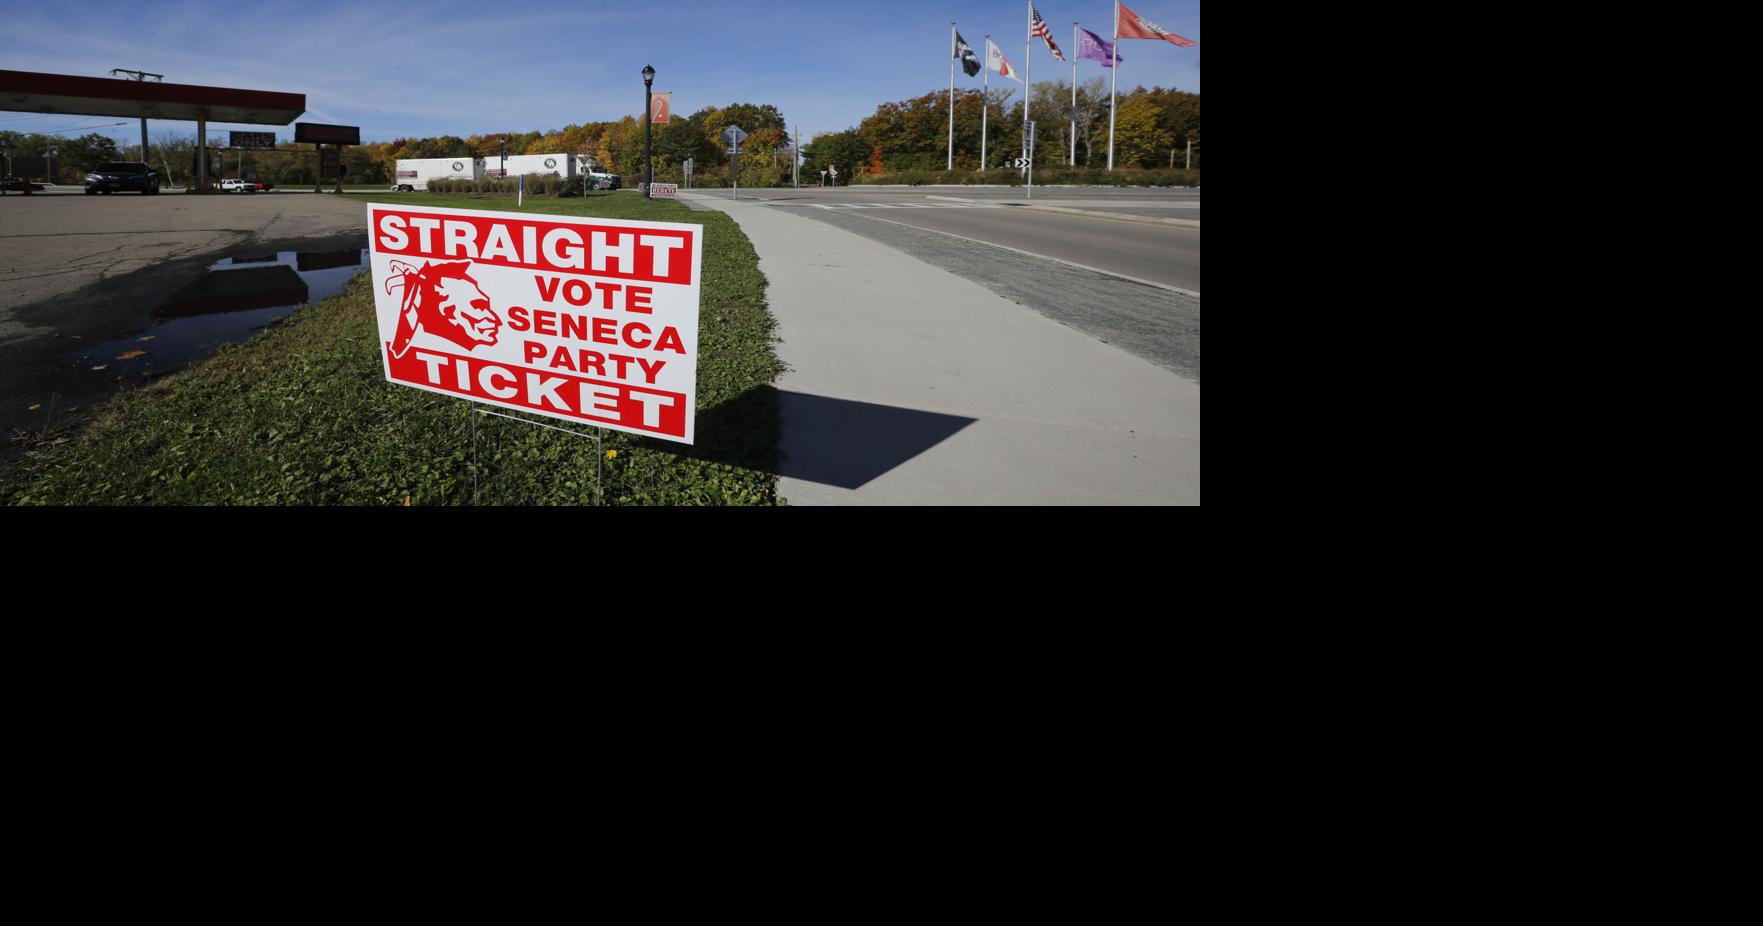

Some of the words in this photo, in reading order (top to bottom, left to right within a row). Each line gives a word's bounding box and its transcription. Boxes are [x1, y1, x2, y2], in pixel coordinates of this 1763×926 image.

[379, 214, 685, 278] STRAIGHT
[534, 275, 653, 315] VOTE
[507, 306, 687, 355] SENECA
[524, 340, 667, 384] PARTY
[415, 351, 675, 429] TICKET
